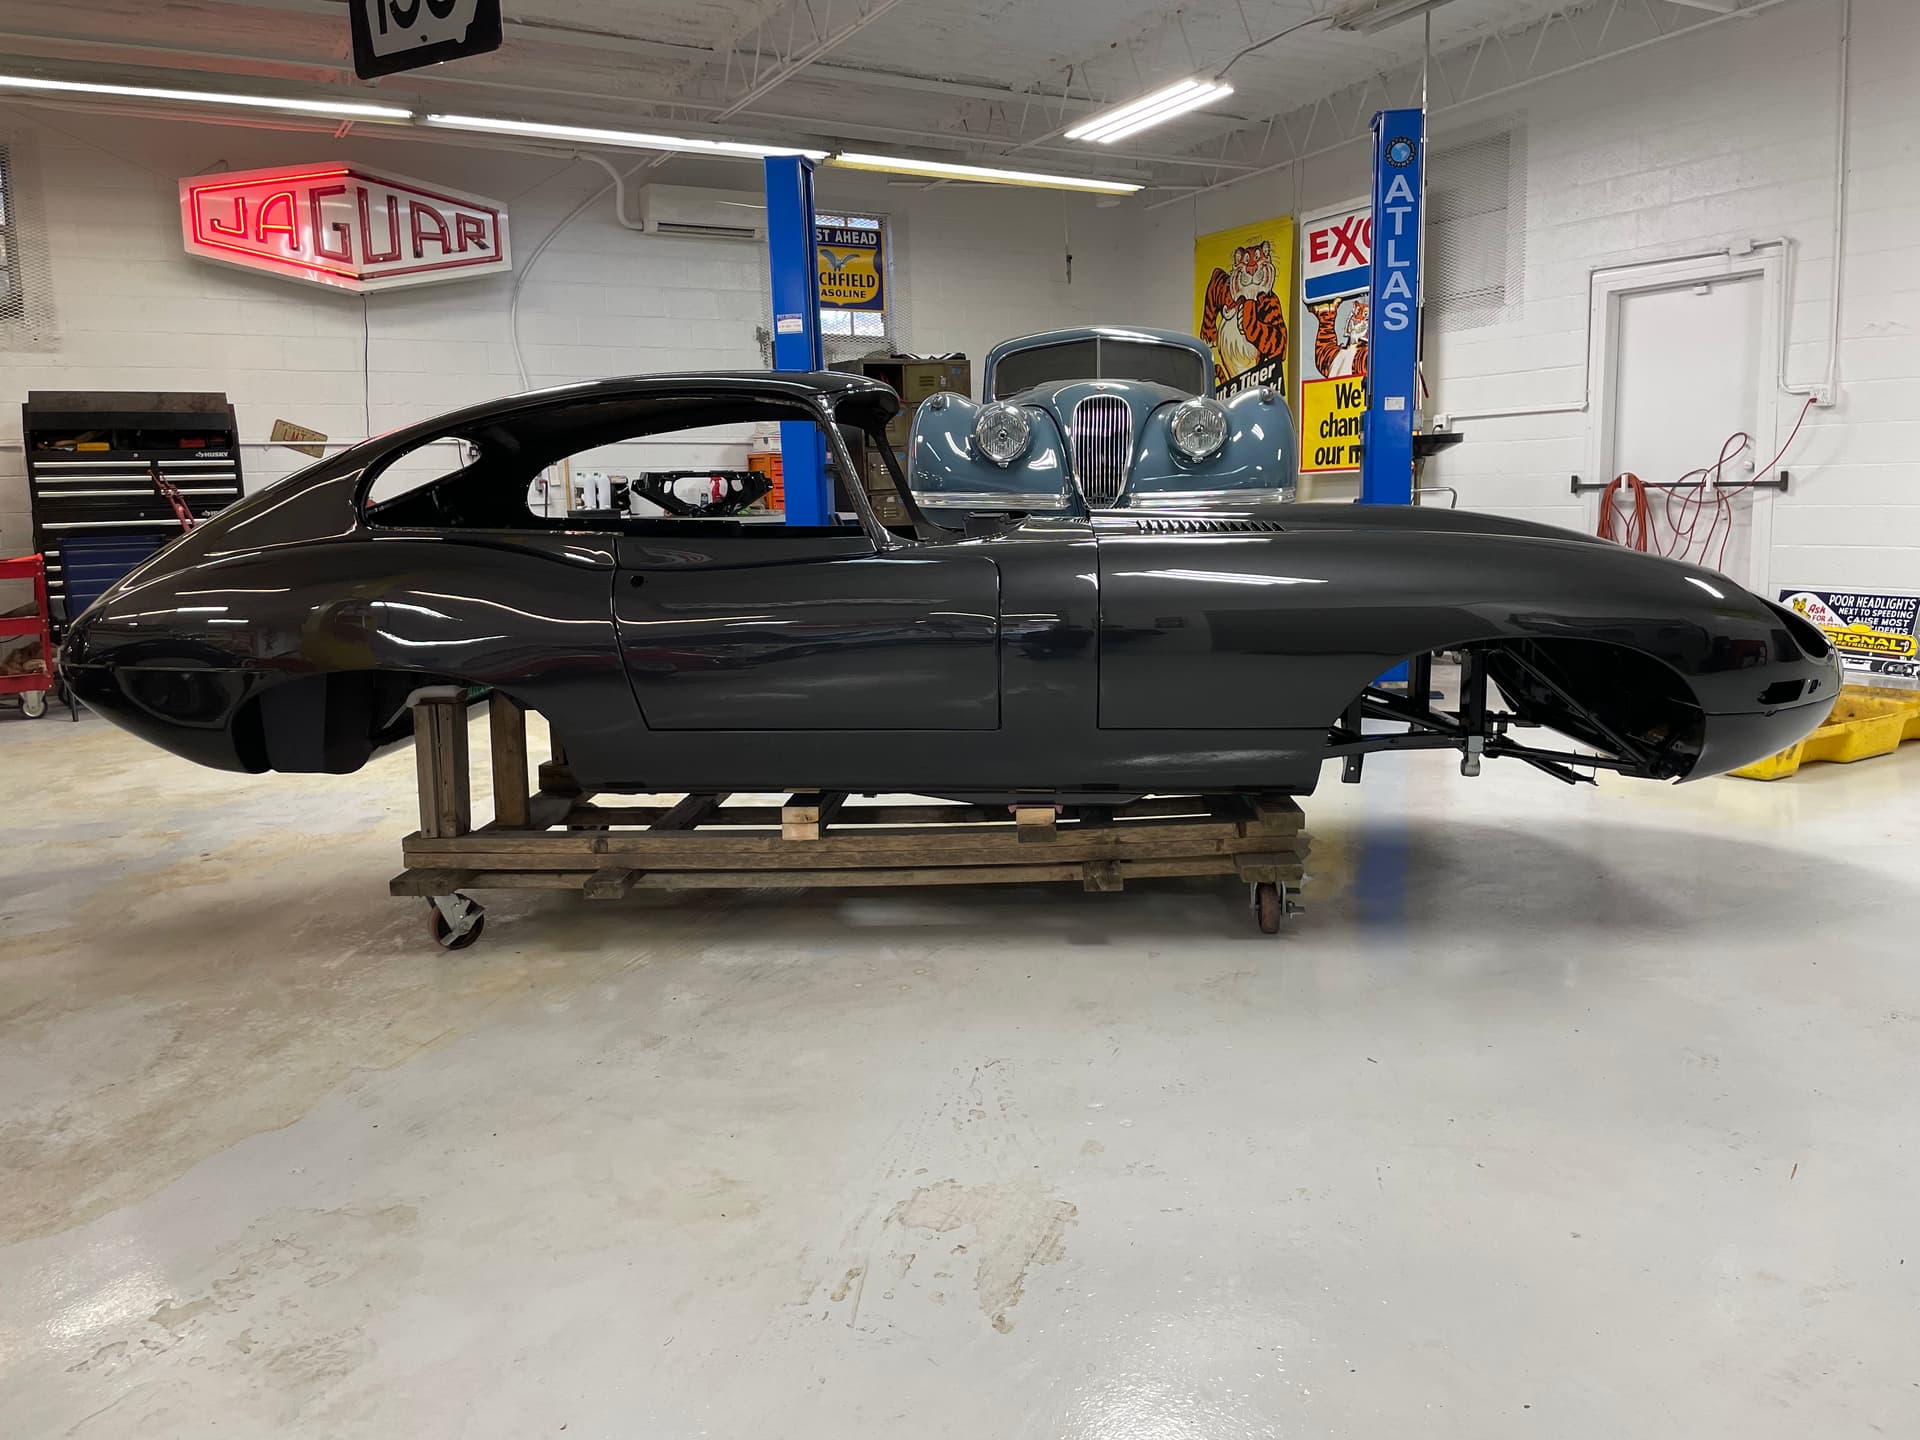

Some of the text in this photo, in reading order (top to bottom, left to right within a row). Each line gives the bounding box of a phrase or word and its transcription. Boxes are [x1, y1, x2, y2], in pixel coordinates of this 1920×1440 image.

[210, 184, 490, 265] JAGUAR
[836, 231, 877, 245] AHEAD
[1381, 174, 1415, 331] ATLAS
[1240, 363, 1276, 392] Tiger
[1319, 412, 1361, 440] chan
[1315, 446, 1344, 466] our
[1808, 604, 1826, 614] Ask
[1829, 594, 1916, 611] POOR HEADLIGHTS
[1839, 607, 1914, 619] NEXT TO SPEEDING
[1881, 618, 1910, 627] MOST
[1826, 631, 1903, 651] SIGNAL
